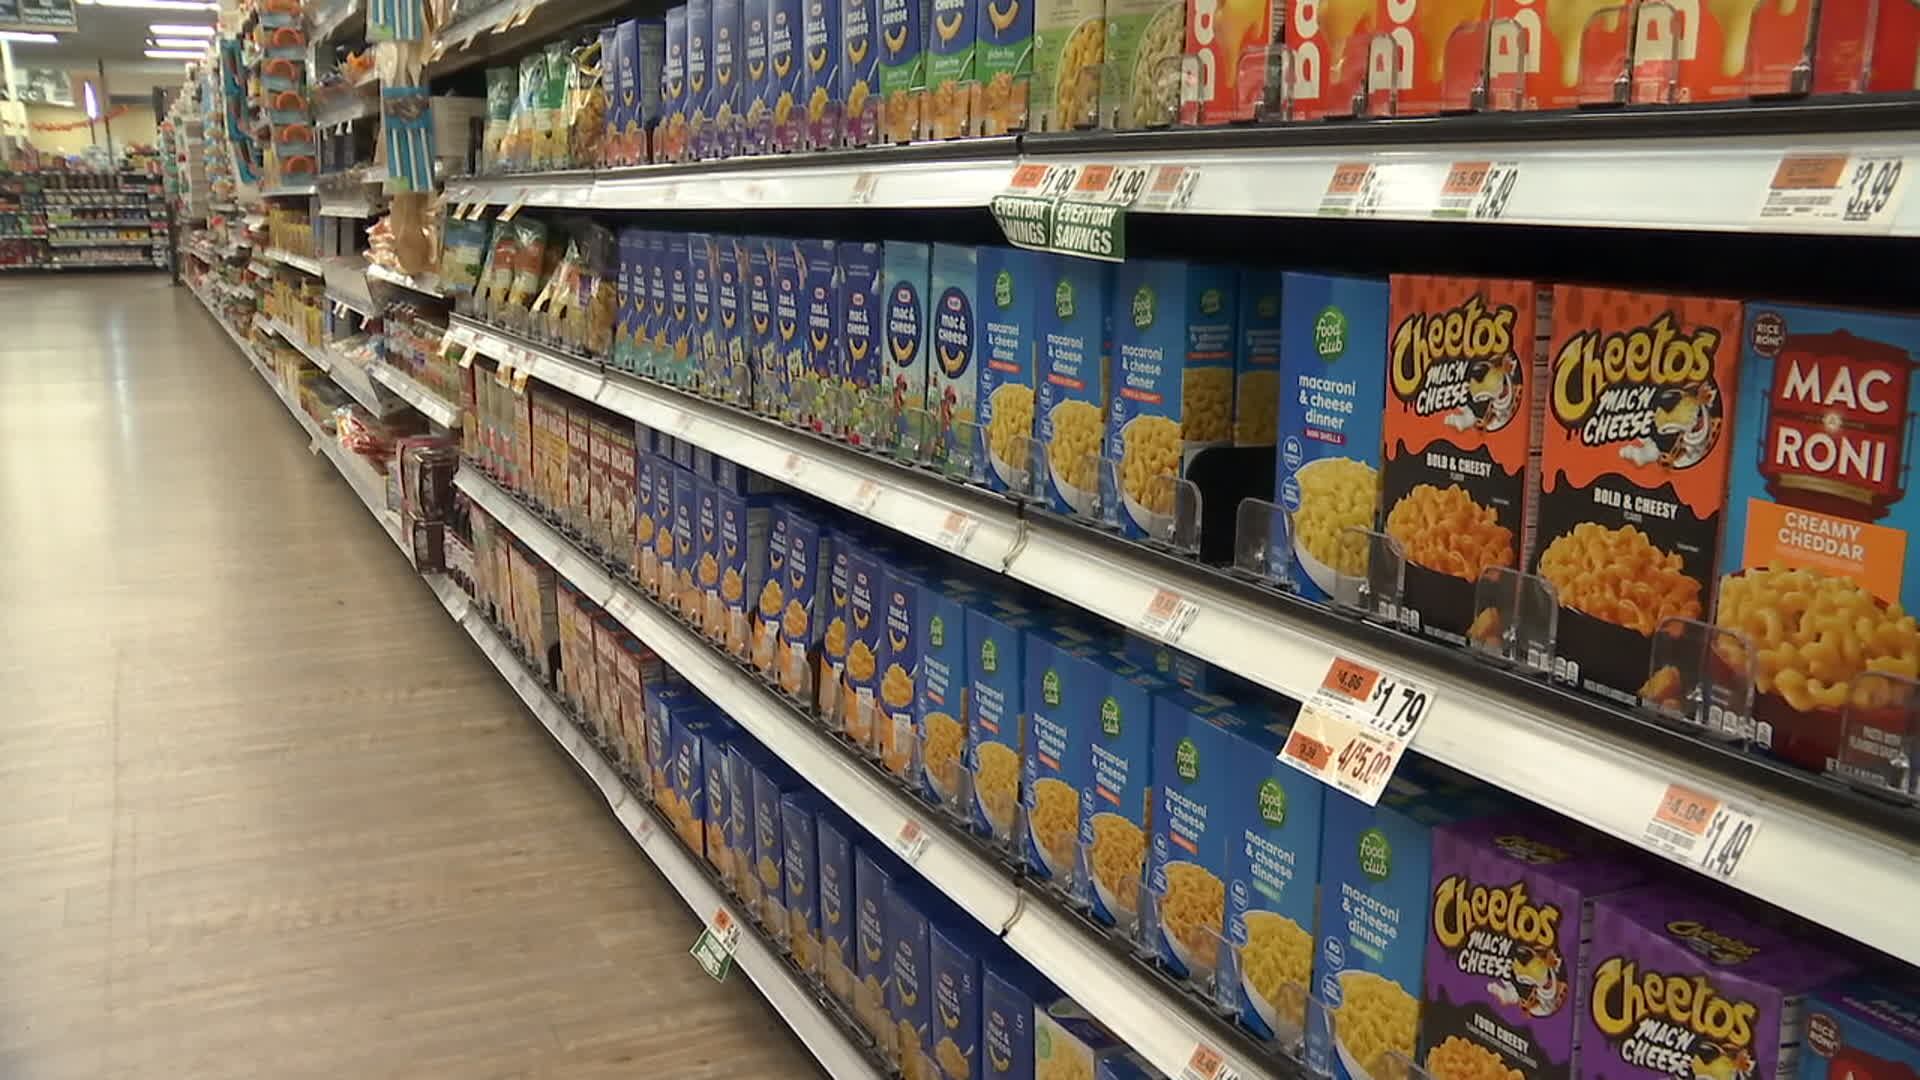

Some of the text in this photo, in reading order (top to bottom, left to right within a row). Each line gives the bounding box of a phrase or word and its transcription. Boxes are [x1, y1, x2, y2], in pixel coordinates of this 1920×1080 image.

[1057, 203, 1118, 227] EVERYDAY
[1054, 224, 1113, 255] SAVINGS
[942, 314, 959, 329] mac
[1315, 318, 1342, 338] food
[938, 327, 968, 346] cheese
[1318, 335, 1344, 355] club
[1392, 296, 1514, 397] Cheetos
[1121, 345, 1163, 361] macaroni
[1129, 358, 1161, 376] cheese
[1554, 314, 1717, 421] Cheetos
[1126, 373, 1154, 390] dinner
[1298, 374, 1357, 398] macaroni
[1782, 359, 1894, 413] MAC
[1299, 389, 1354, 415] & cheese
[1415, 382, 1471, 416] CHEESE
[1598, 386, 1656, 415] MAC'N
[1304, 409, 1345, 429] dinner
[1583, 410, 1655, 445] CHEESE
[1426, 452, 1448, 470] BOLD
[1449, 456, 1457, 471] &
[1458, 458, 1492, 478] CHEESY
[1775, 426, 1887, 483] RONI
[1593, 487, 1622, 508] BOLD
[1623, 494, 1632, 510] &
[1634, 496, 1678, 520] CHEESY
[1785, 511, 1862, 541] CREAMY
[1777, 527, 1865, 562] CHEDDAR
[1164, 785, 1207, 818] macaroni
[1259, 785, 1282, 808] food
[1173, 805, 1206, 832] cheese
[1262, 804, 1284, 822] club
[1169, 817, 1199, 842] dinner
[1244, 829, 1296, 866] macaroni
[1360, 836, 1387, 859] food
[1250, 862, 1286, 890] dinner
[1255, 850, 1293, 880] cheese
[1363, 857, 1387, 877] club
[1342, 881, 1400, 924] macaroni
[1433, 876, 1560, 949] Cheetos
[1342, 897, 1398, 939] & cheese
[1347, 918, 1388, 950] dinner
[1458, 950, 1514, 979] CHEESE
[1591, 958, 1756, 1047] Cheetos
[1621, 1038, 1695, 1078] CHEESE
